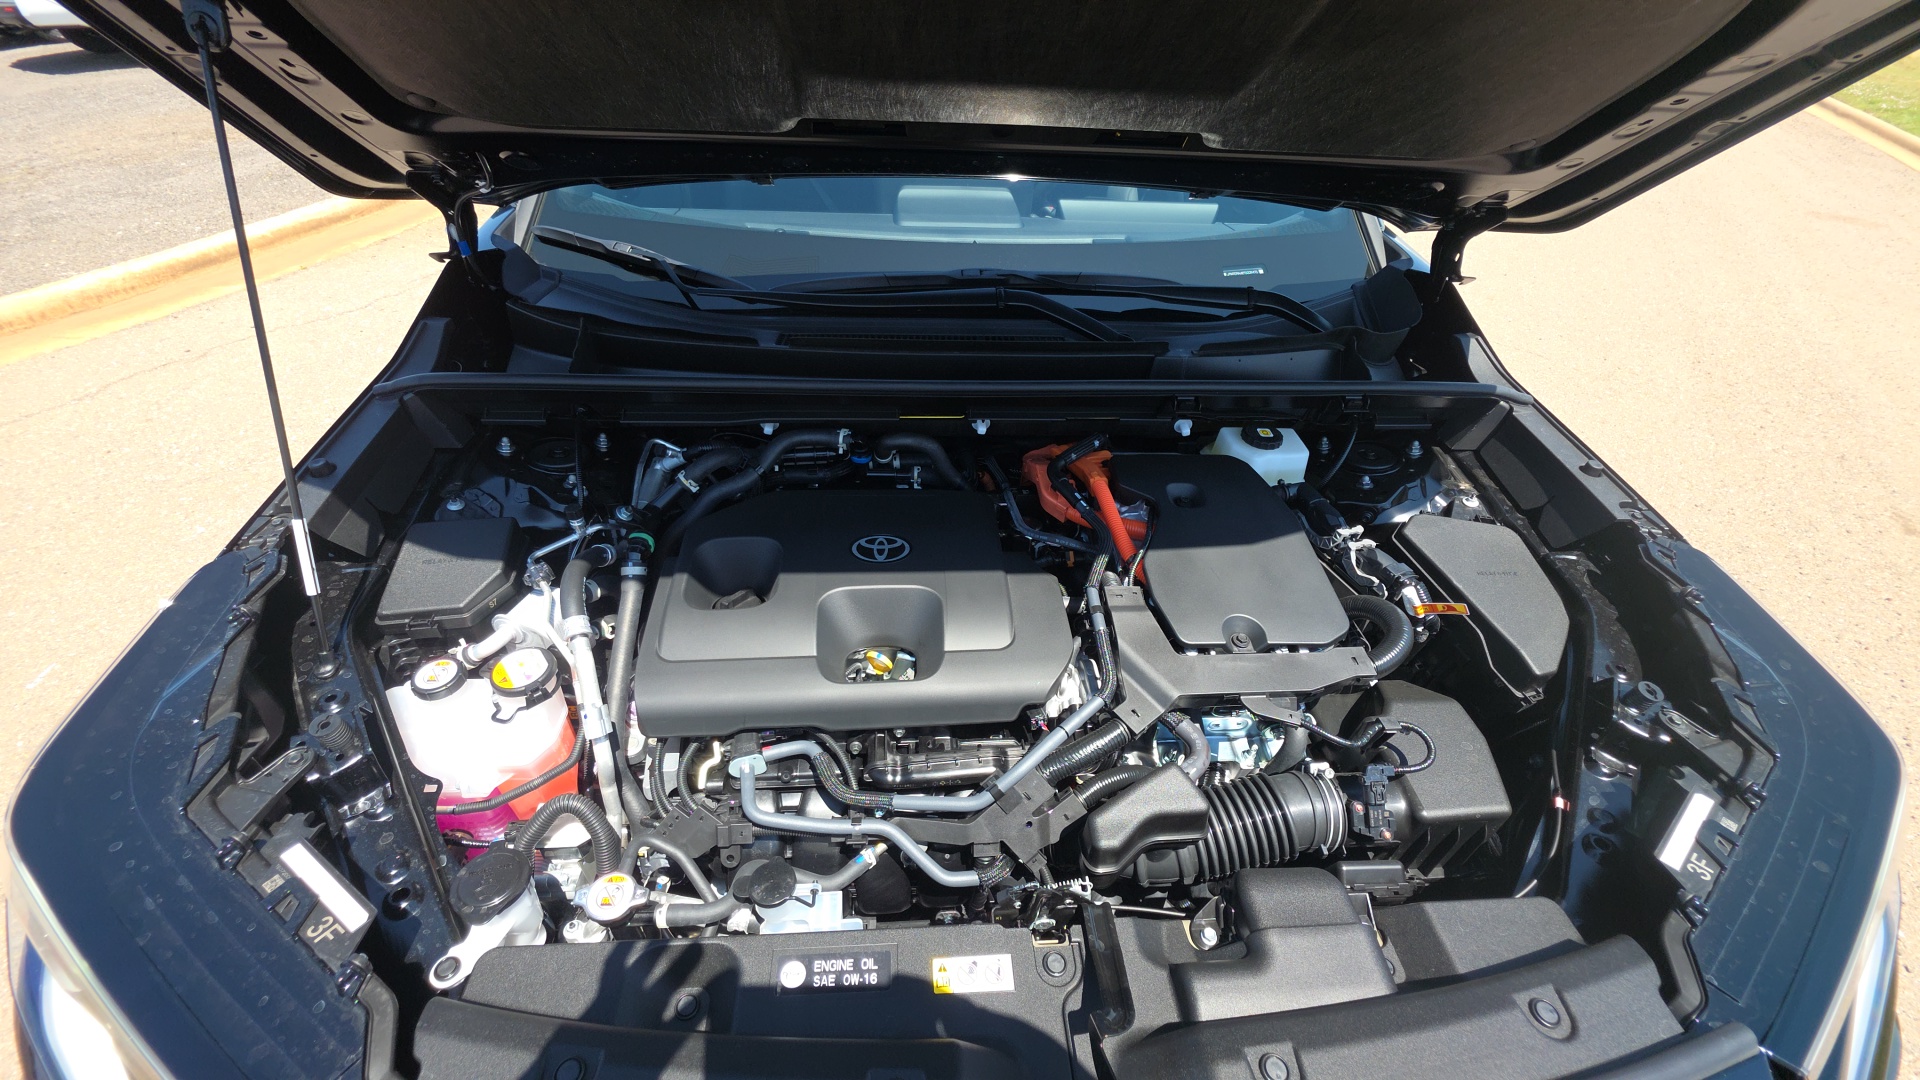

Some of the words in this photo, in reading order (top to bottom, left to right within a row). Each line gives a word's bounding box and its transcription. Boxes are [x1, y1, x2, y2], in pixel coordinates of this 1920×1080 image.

[488, 597, 498, 609] S7
[1686, 852, 1714, 881] 3F
[306, 915, 346, 944] 3F
[814, 959, 854, 972] ENGINE
[861, 958, 878, 970] OIL
[813, 974, 836, 987] SAE
